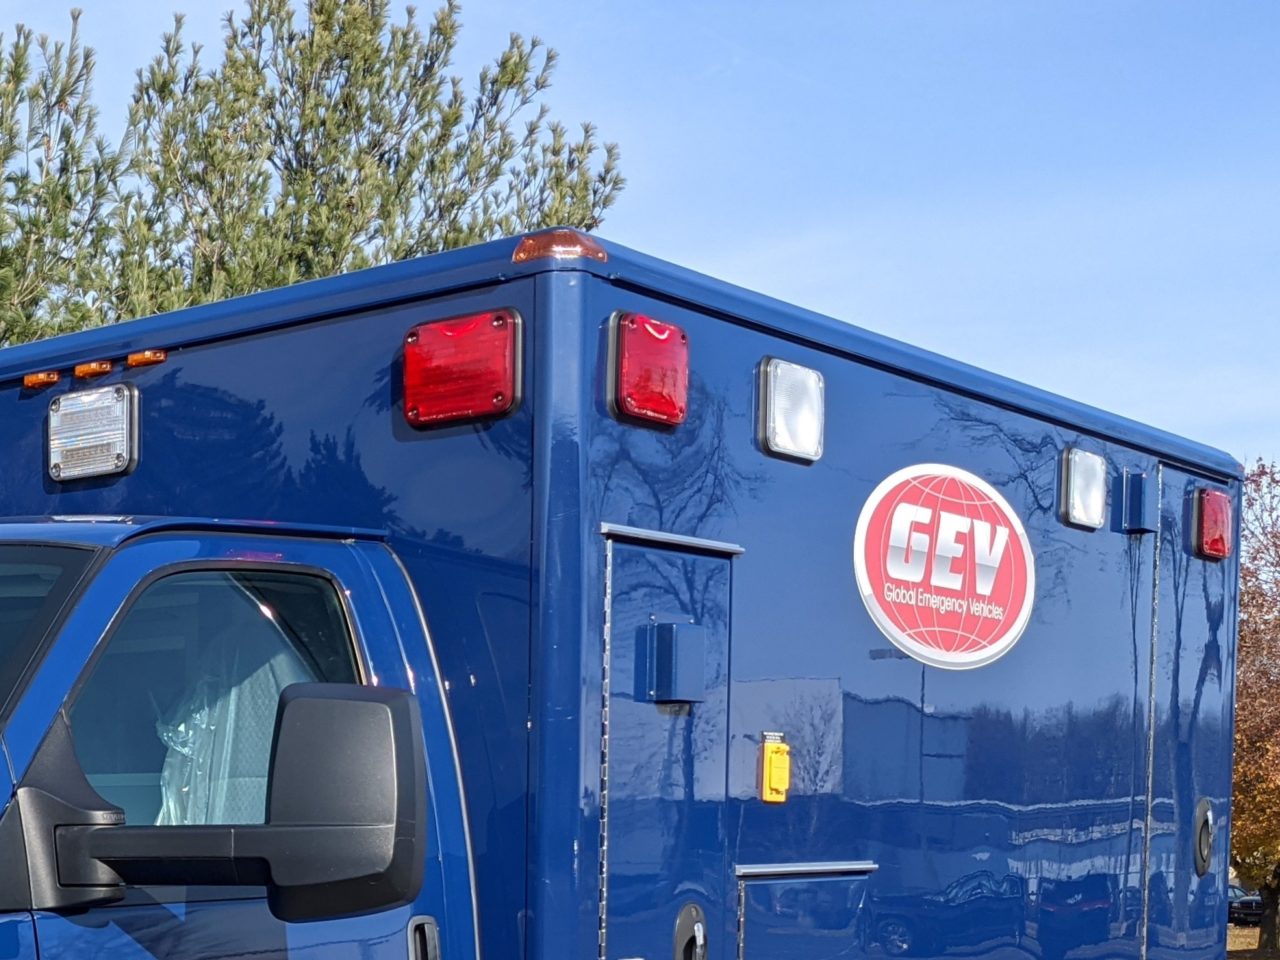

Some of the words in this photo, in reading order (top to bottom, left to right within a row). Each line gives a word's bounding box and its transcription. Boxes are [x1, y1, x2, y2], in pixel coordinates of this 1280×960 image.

[886, 502, 1009, 597] GEV
[884, 583, 915, 606] Global
[918, 588, 967, 614] Emergency
[969, 598, 1004, 620] Vehicles
